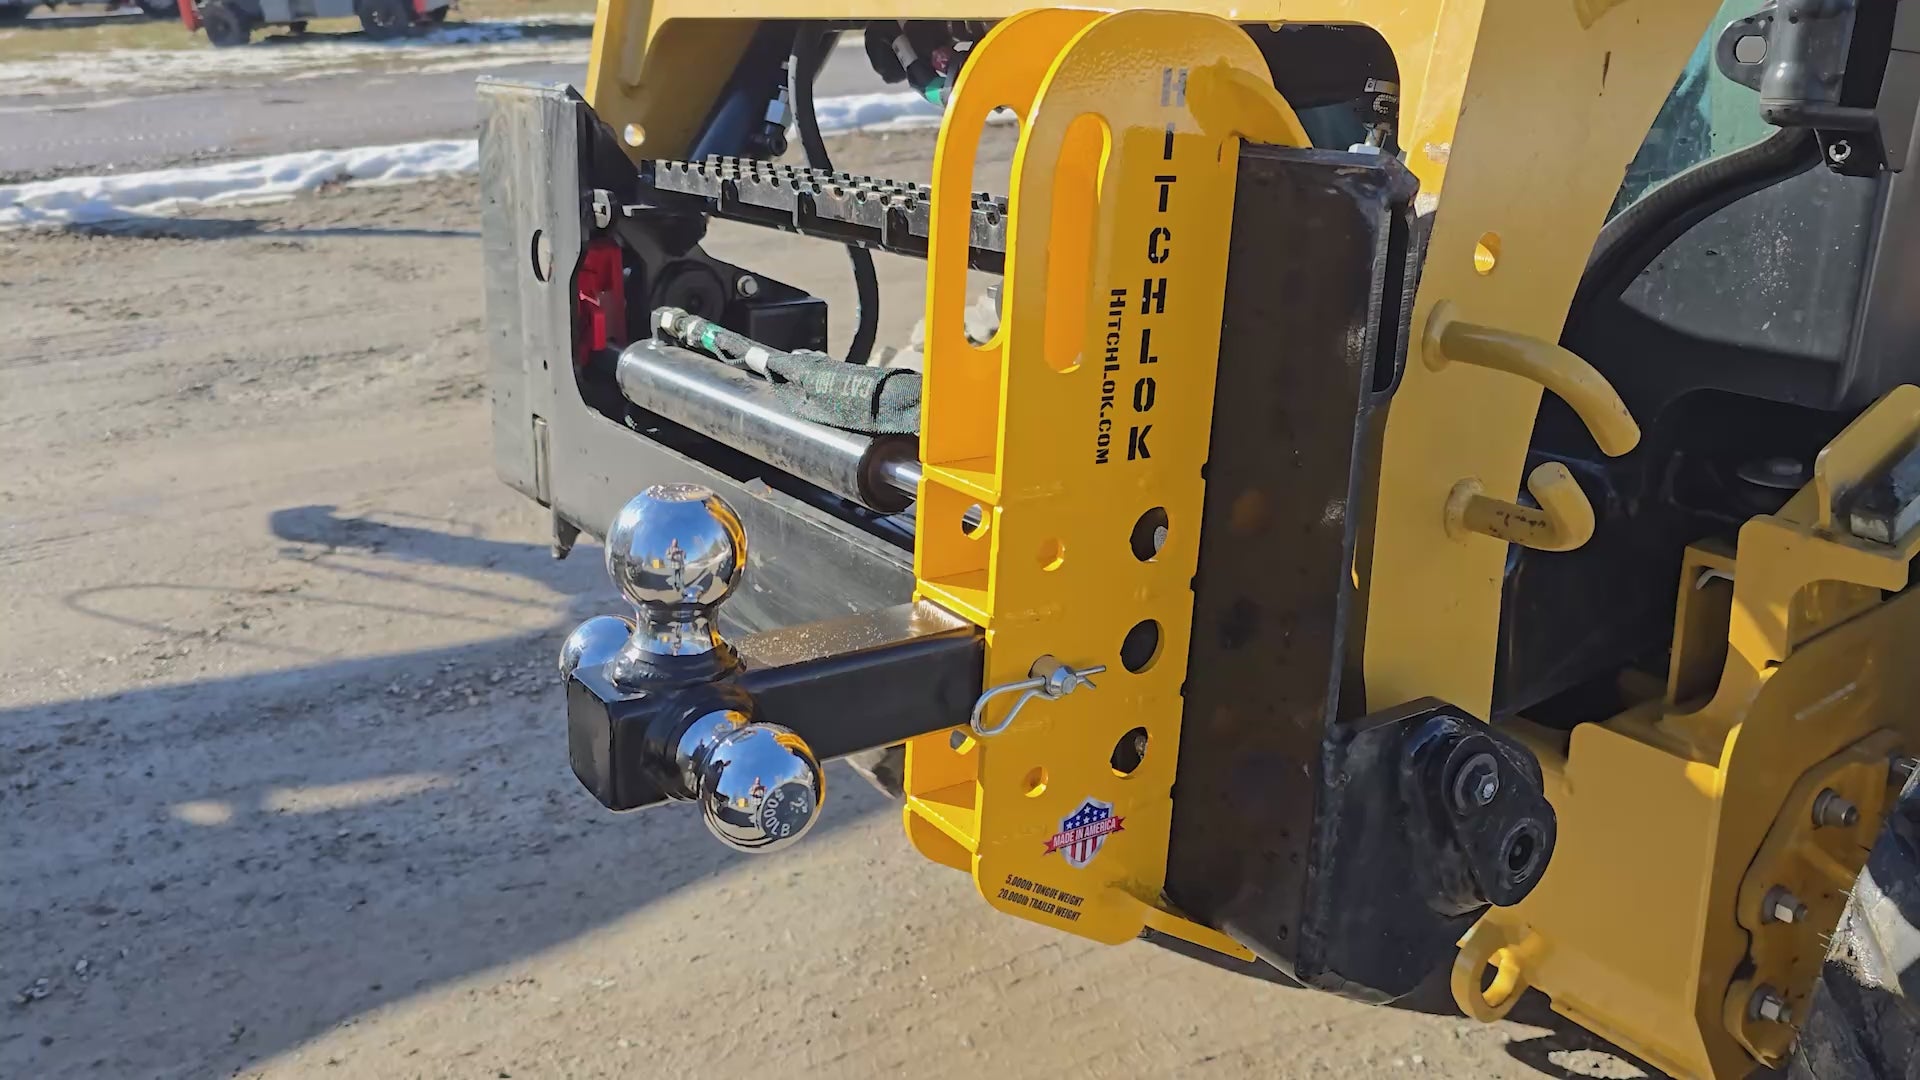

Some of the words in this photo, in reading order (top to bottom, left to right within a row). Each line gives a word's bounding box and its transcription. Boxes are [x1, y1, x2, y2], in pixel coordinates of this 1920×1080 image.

[1127, 67, 1188, 461] HITCHLOK
[1095, 288, 1127, 465] HITCHLOK.COM
[1053, 830, 1075, 848] MADE
[1075, 828, 1084, 840] IN
[1084, 818, 1116, 837] AMERICA
[1028, 898, 1056, 914] TRAILER
[1055, 906, 1082, 921] WEIGHT
[1032, 883, 1059, 898] TONGUE
[1058, 891, 1084, 907] WEIGHT
